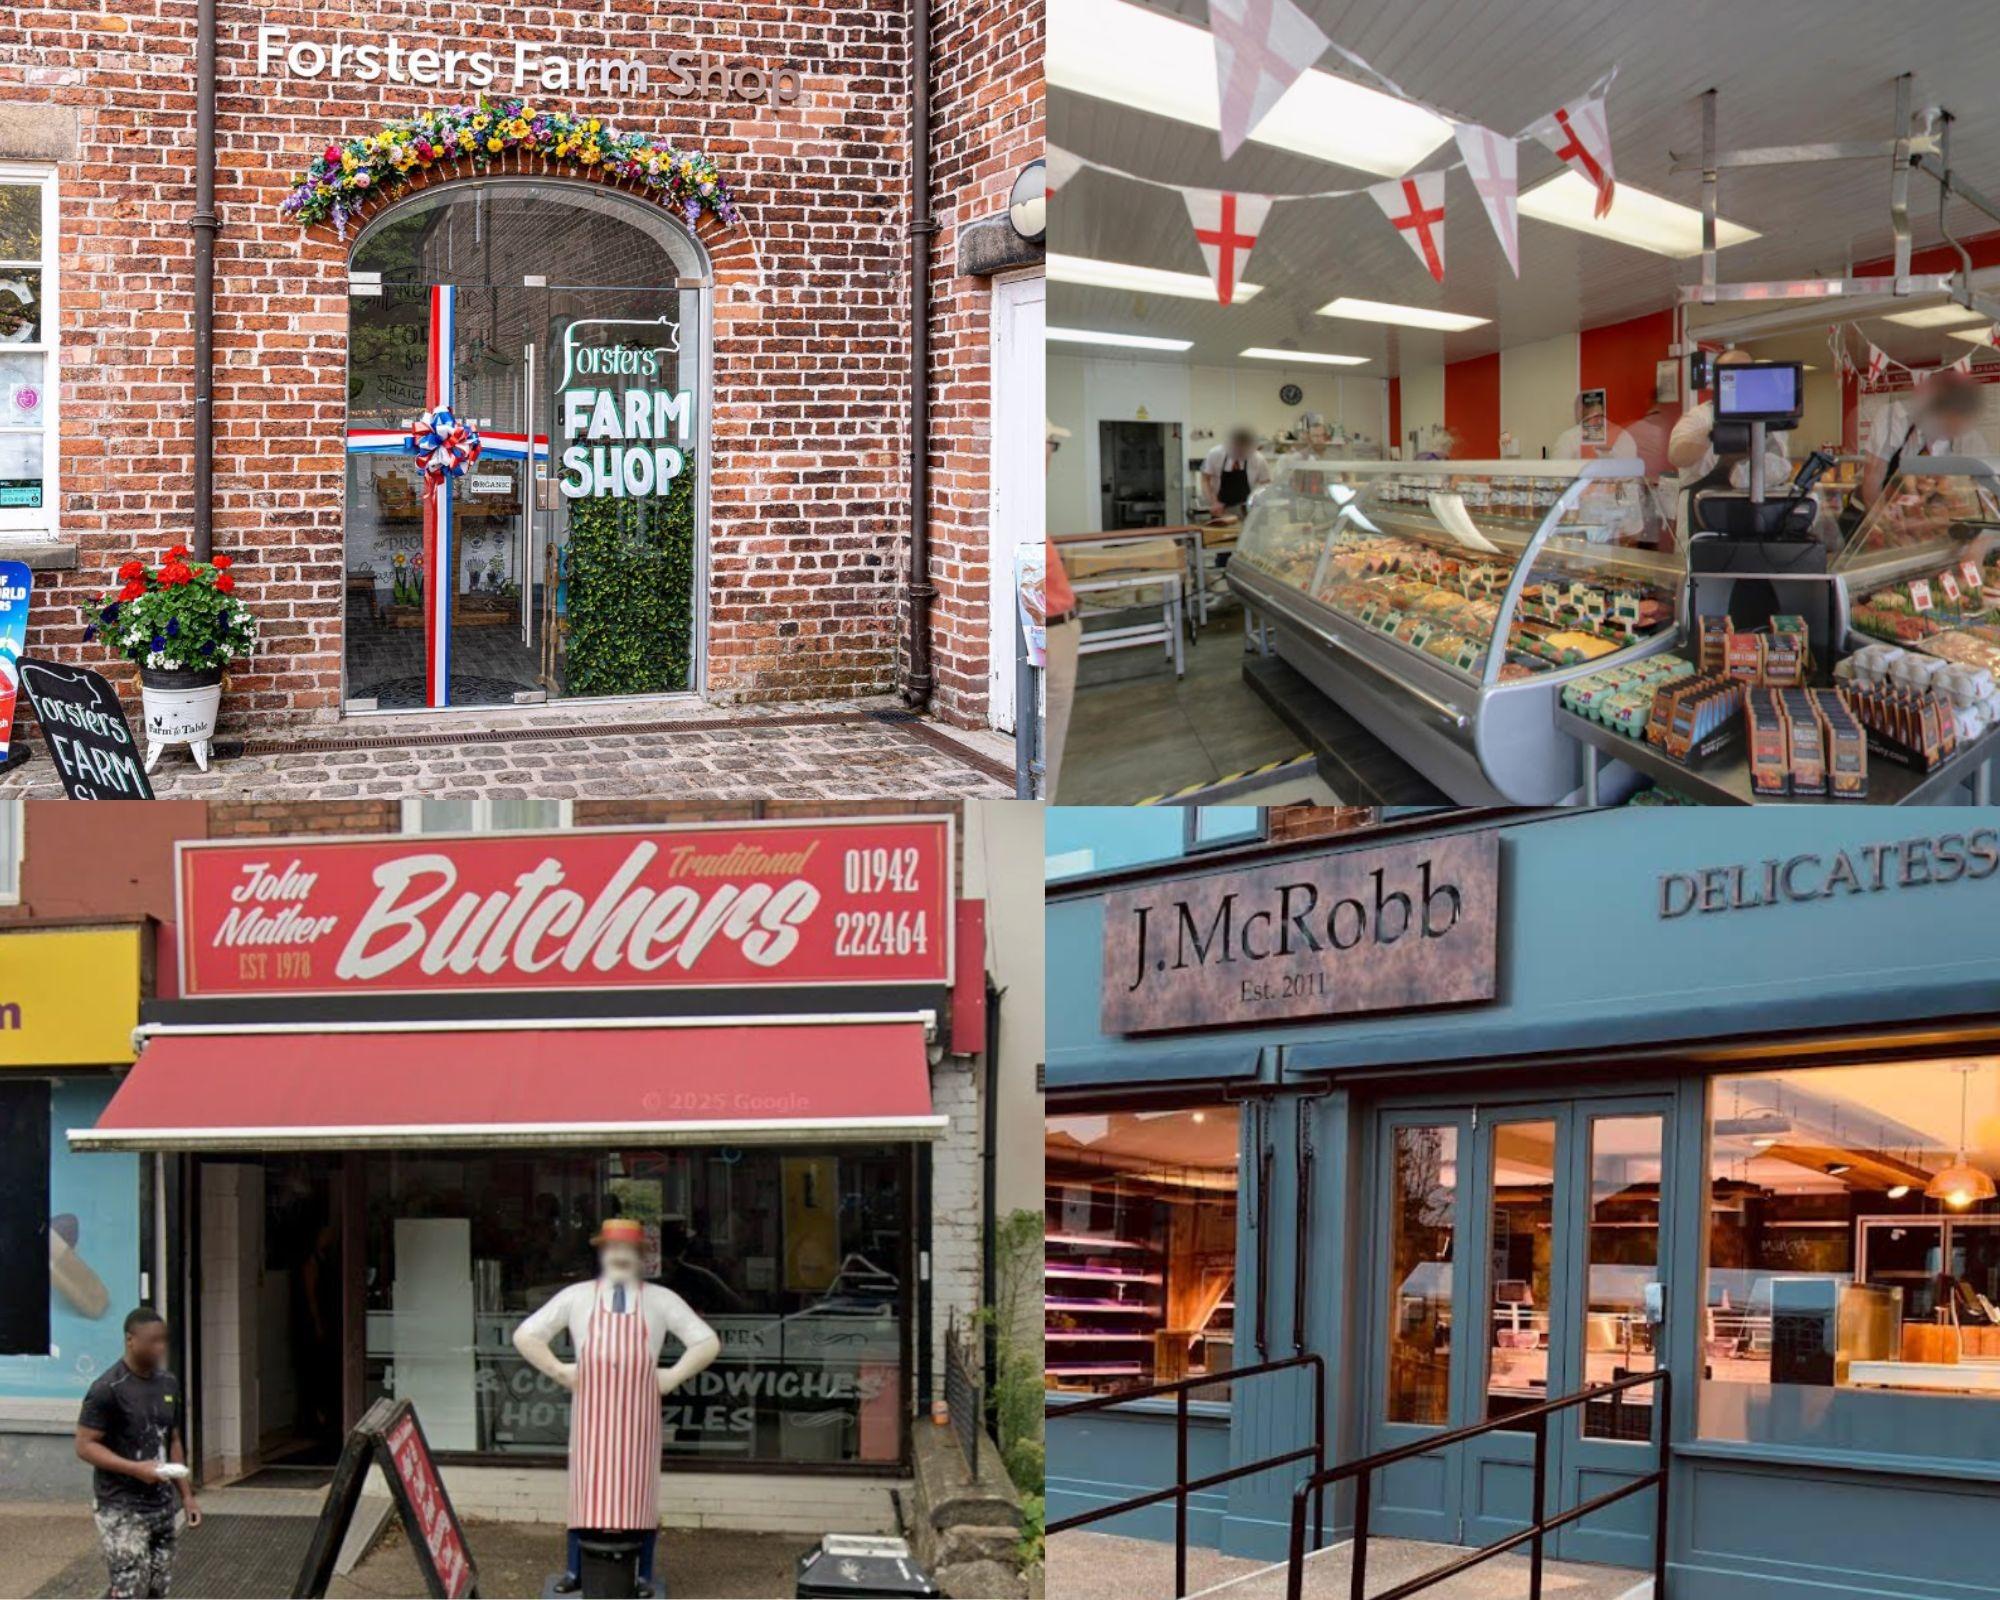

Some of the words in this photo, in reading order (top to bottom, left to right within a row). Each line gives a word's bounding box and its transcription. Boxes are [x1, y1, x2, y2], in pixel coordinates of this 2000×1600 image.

[258, 27, 495, 87] Forsters
[513, 42, 649, 95] Farm
[666, 50, 801, 110] Shop
[555, 328, 661, 394] Forsters
[563, 386, 693, 440] FARM
[559, 444, 685, 499] SHOP
[26, 684, 130, 745] Forsters
[148, 723, 172, 736] Farm
[181, 721, 208, 734] Table
[51, 733, 151, 800] FARM
[230, 858, 319, 903] John
[668, 840, 821, 879] Traditional
[844, 847, 920, 895] 01942
[1657, 827, 2000, 920] DELICATESS
[212, 902, 339, 948] Mather
[334, 840, 821, 980] Butchers
[834, 910, 928, 957] 222464
[1128, 859, 1462, 992] J.McRobb
[239, 952, 268, 980] EST
[276, 950, 312, 980] 1978
[1240, 978, 1276, 1002] Est.
[1282, 971, 1326, 999] 2011
[670, 1371, 884, 1400] NDWICHES
